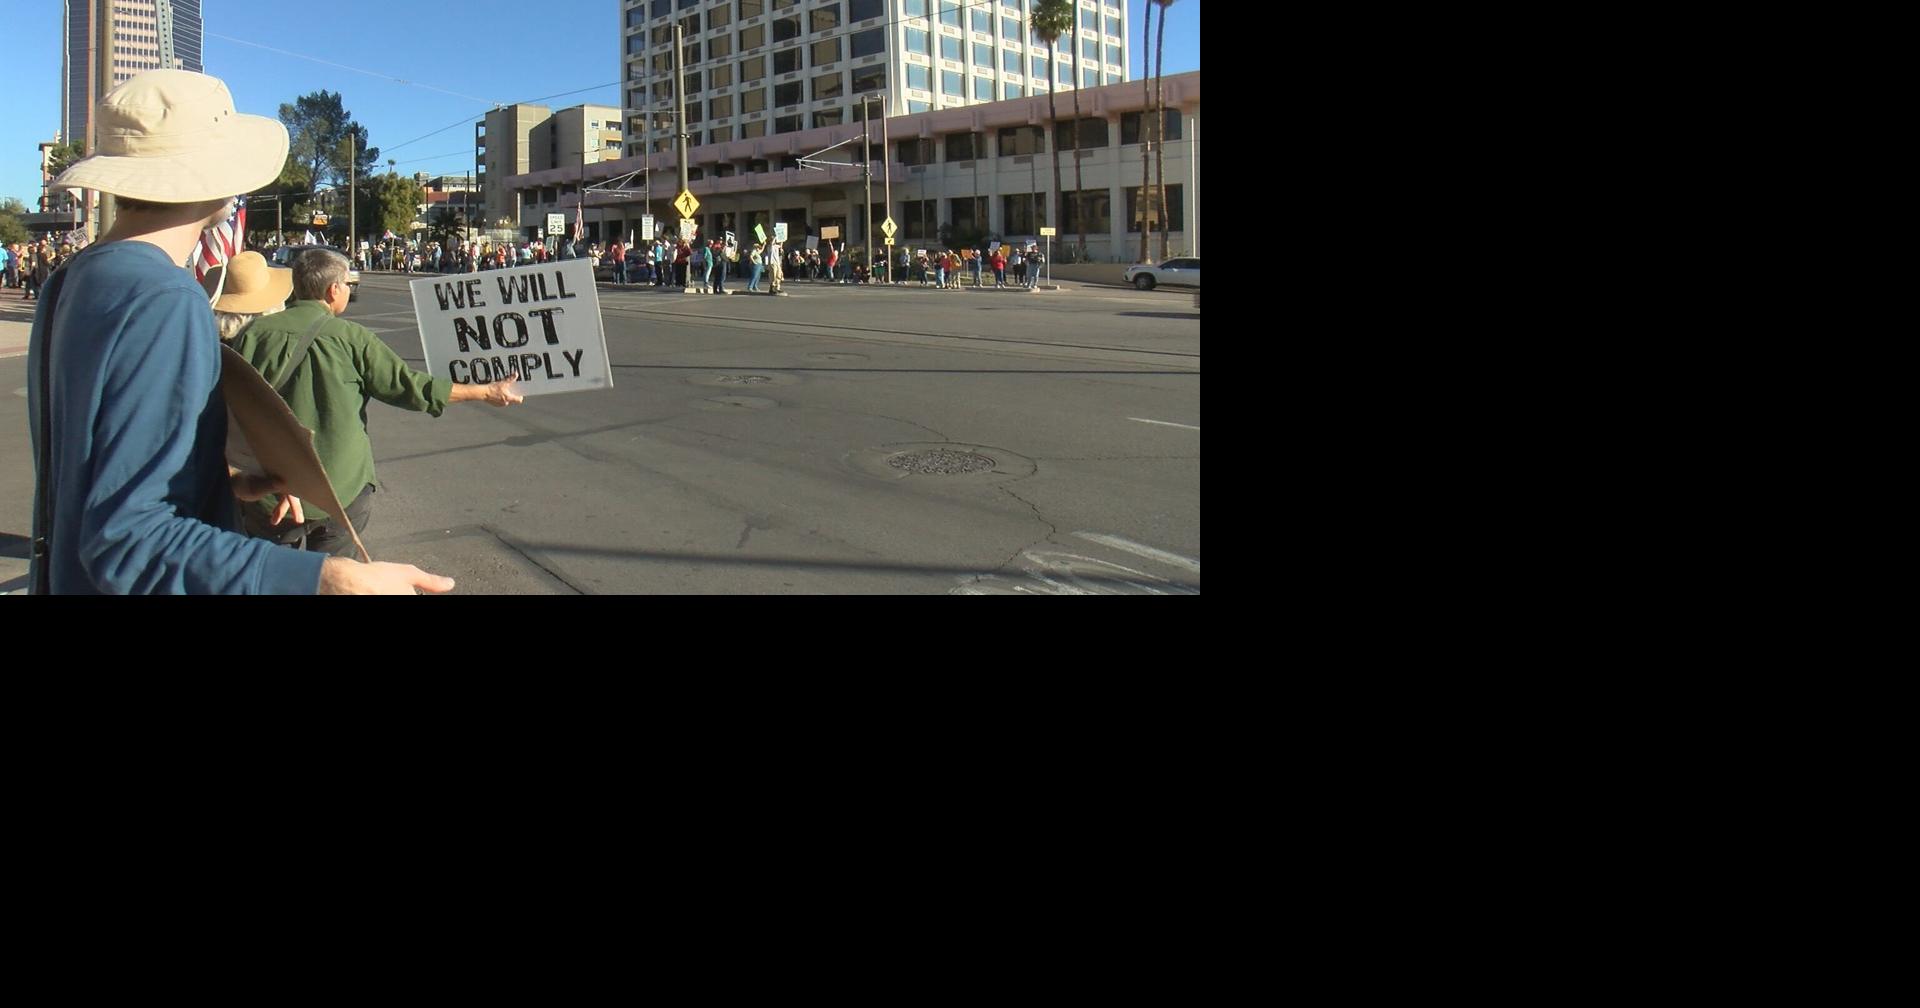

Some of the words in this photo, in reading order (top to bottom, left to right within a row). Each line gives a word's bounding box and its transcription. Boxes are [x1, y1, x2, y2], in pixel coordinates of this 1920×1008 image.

[550, 224, 563, 232] 25
[434, 279, 486, 311] WE
[497, 271, 576, 304] WILL
[453, 307, 565, 352] NOT
[449, 349, 583, 385] COMPLY
